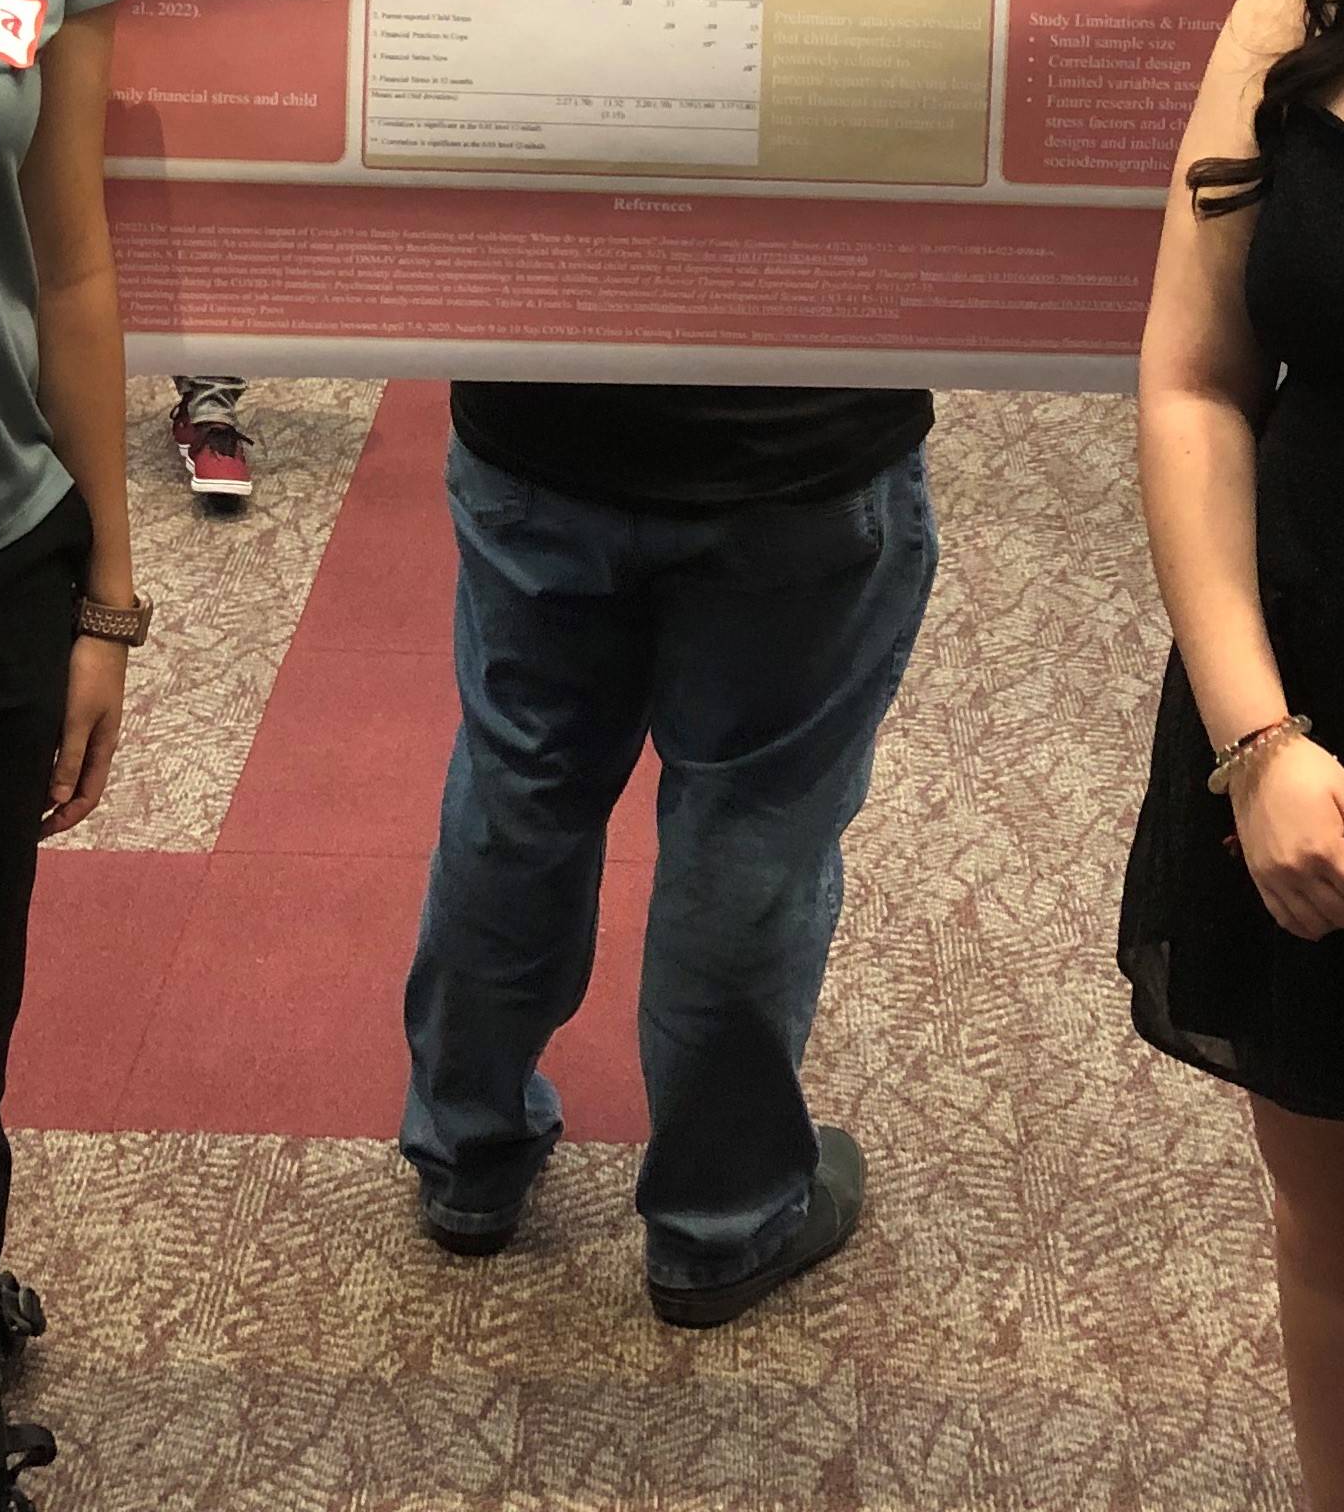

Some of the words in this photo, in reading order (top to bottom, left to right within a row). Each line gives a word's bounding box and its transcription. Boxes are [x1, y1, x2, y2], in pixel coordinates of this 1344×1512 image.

[1029, 12, 1069, 29] Study
[1075, 12, 1154, 28] Limitations
[1160, 17, 1171, 29] &
[1050, 33, 1090, 47] Small
[1095, 35, 1143, 52] sample
[1148, 39, 1175, 49] size
[1048, 54, 1140, 68] Correlational
[1145, 56, 1190, 73] design
[614, 197, 692, 213] References
